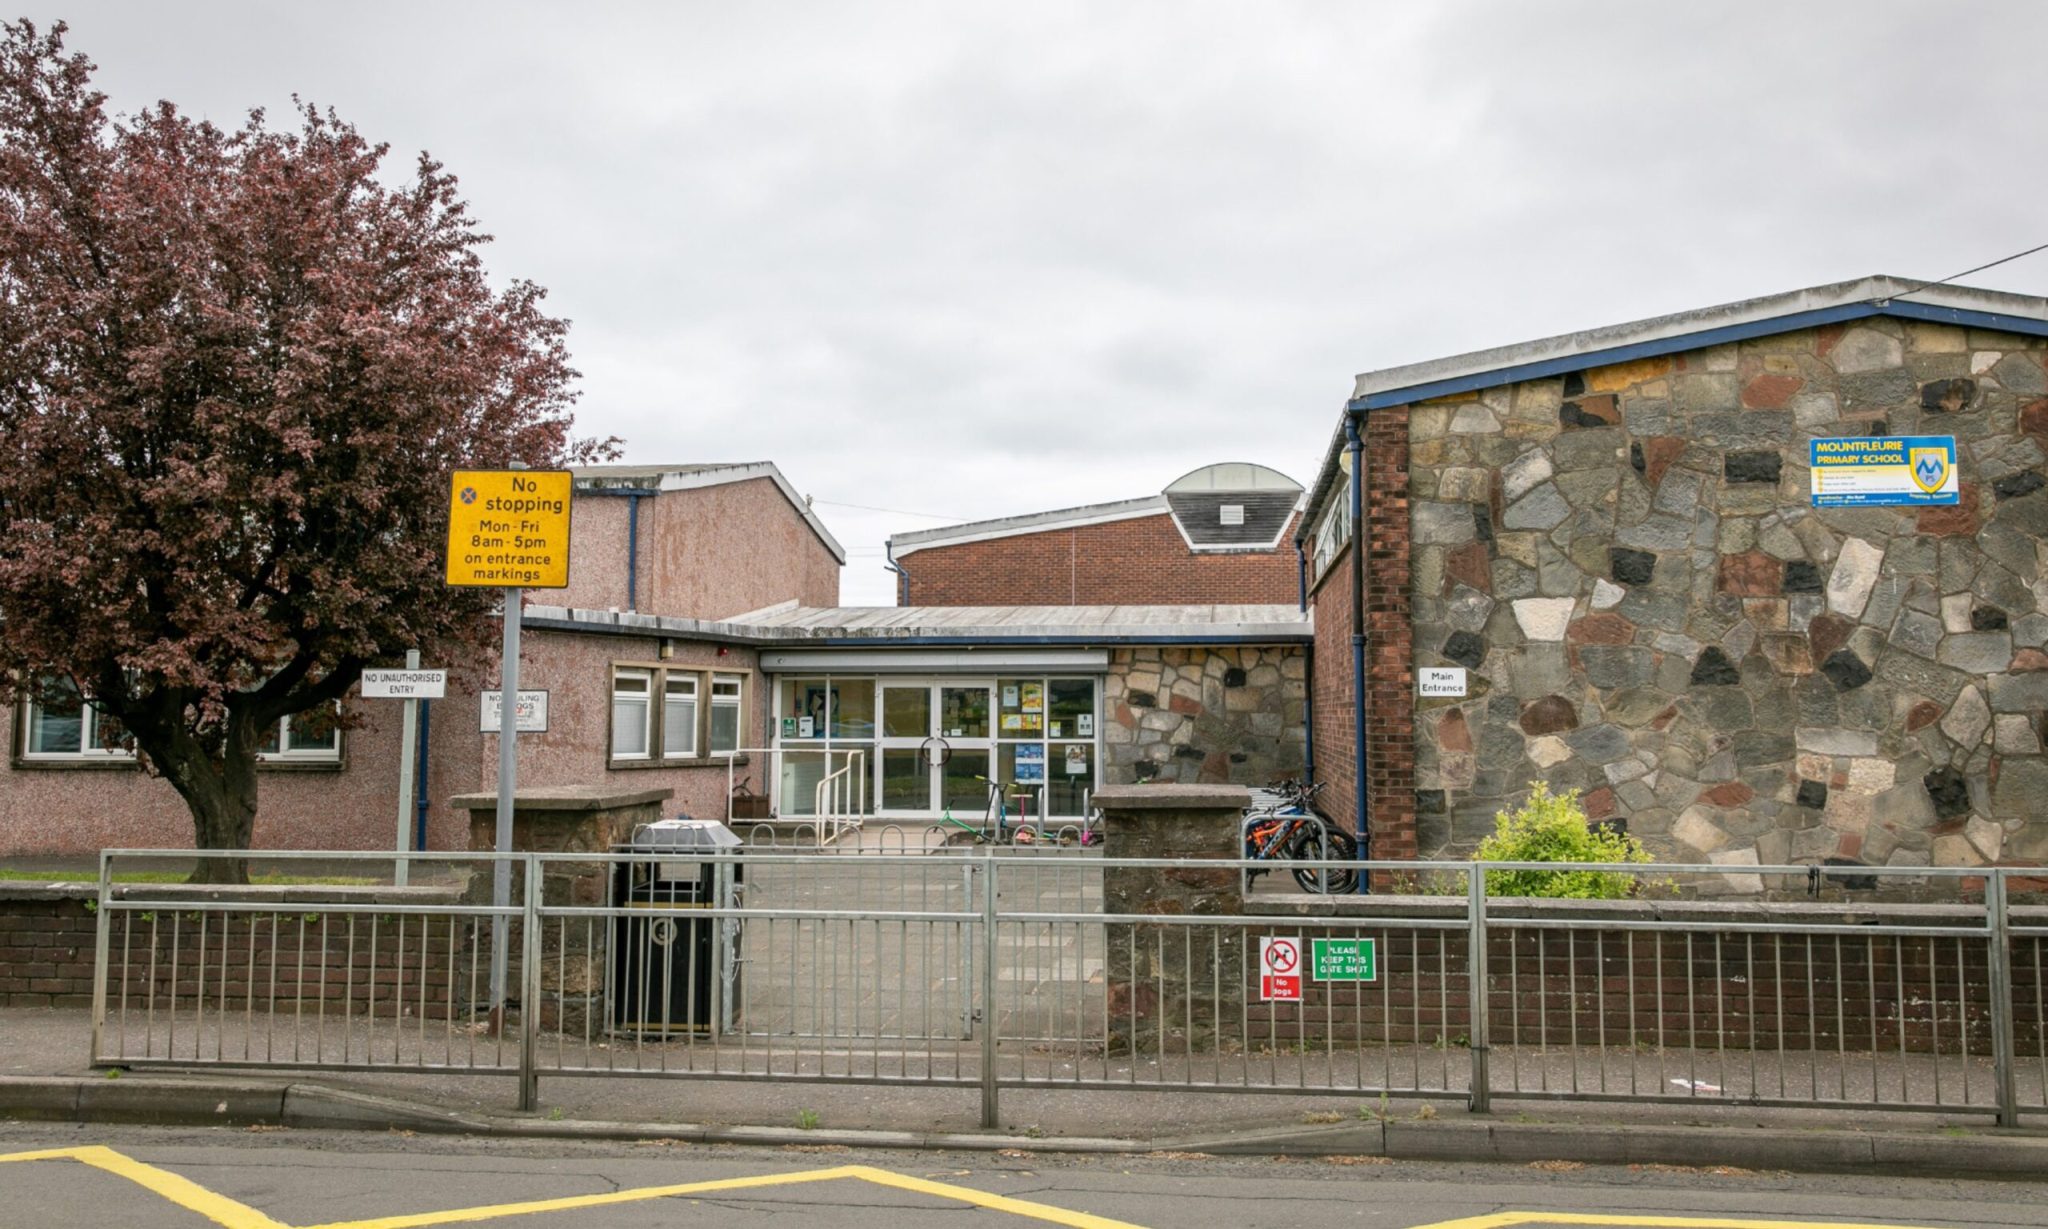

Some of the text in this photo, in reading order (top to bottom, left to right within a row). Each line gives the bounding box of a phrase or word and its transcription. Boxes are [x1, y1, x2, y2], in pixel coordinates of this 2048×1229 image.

[1816, 441, 1904, 452] MOUNTFLEURIE
[1817, 454, 1904, 464] PRIMARY SCHOOL
[512, 477, 537, 492] No
[486, 496, 563, 514] stopping
[480, 520, 510, 533] Mon
[521, 520, 540, 533] Fri
[471, 535, 503, 547] 8am
[514, 536, 546, 549] 5pm
[464, 553, 551, 565] on entrance
[473, 568, 540, 582] markings
[365, 673, 442, 682] NO UNAUTHORISED
[1431, 672, 1454, 680] Main
[389, 685, 415, 694] ENTRY
[1422, 684, 1463, 692] Entrance
[1276, 978, 1288, 986] No
